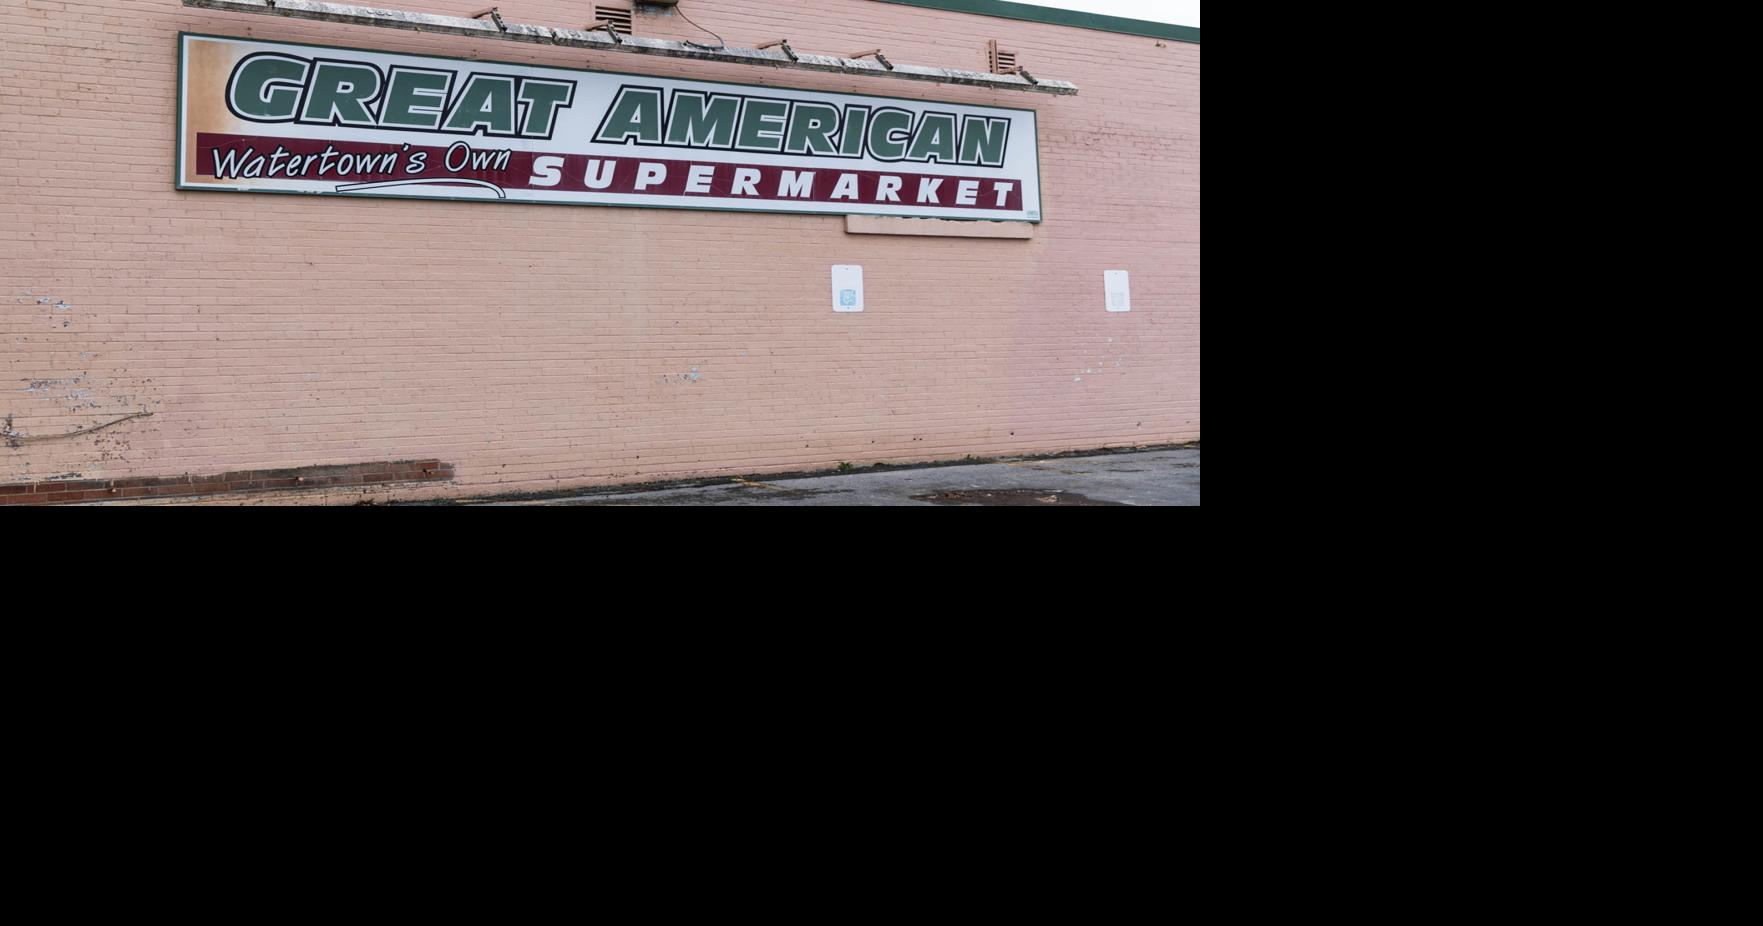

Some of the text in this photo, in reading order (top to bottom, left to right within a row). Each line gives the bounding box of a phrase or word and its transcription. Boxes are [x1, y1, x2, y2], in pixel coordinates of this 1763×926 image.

[224, 51, 1011, 168] GREAT AMERICAN
[211, 140, 512, 180] Watertown's Own
[528, 156, 1014, 208] SUPERMARKET
